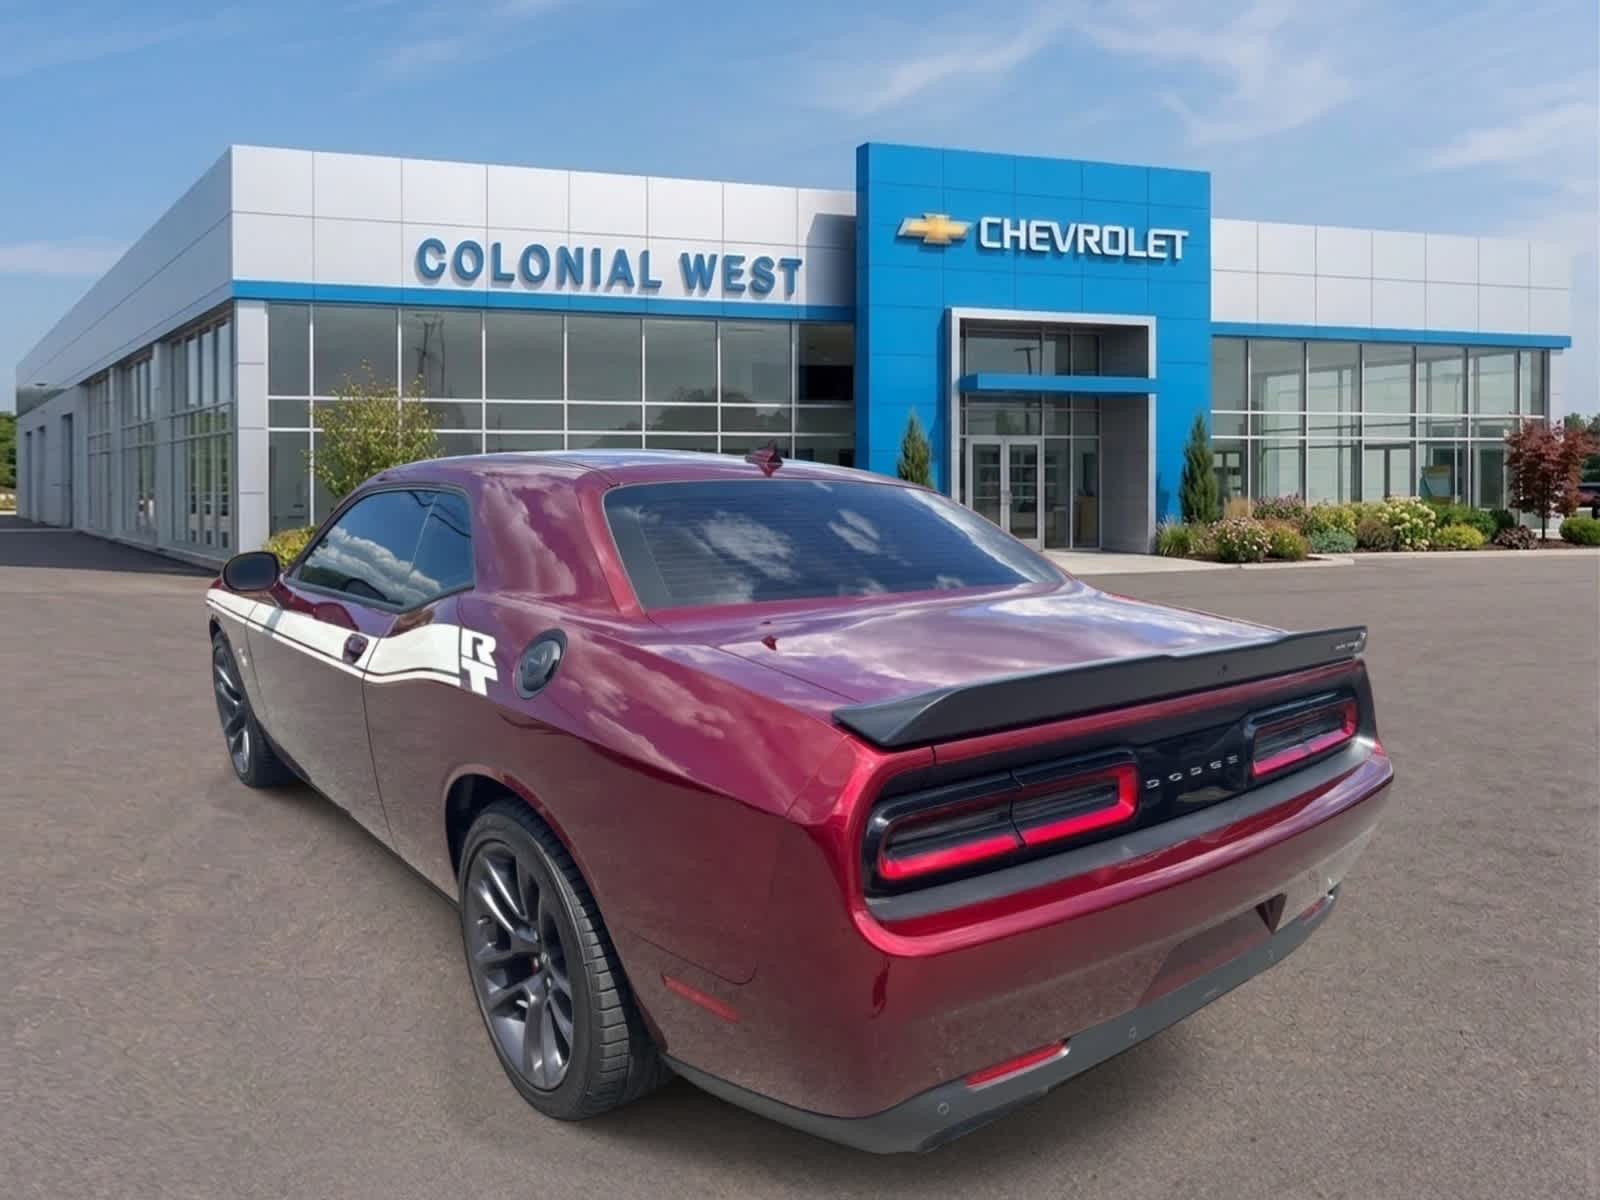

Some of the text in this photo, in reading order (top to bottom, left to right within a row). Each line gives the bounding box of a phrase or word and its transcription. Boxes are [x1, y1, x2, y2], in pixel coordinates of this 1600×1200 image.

[979, 216, 1189, 259] CHEVROLET
[416, 238, 803, 296] COLONIAL WEST
[1145, 754, 1239, 789] DODGE
